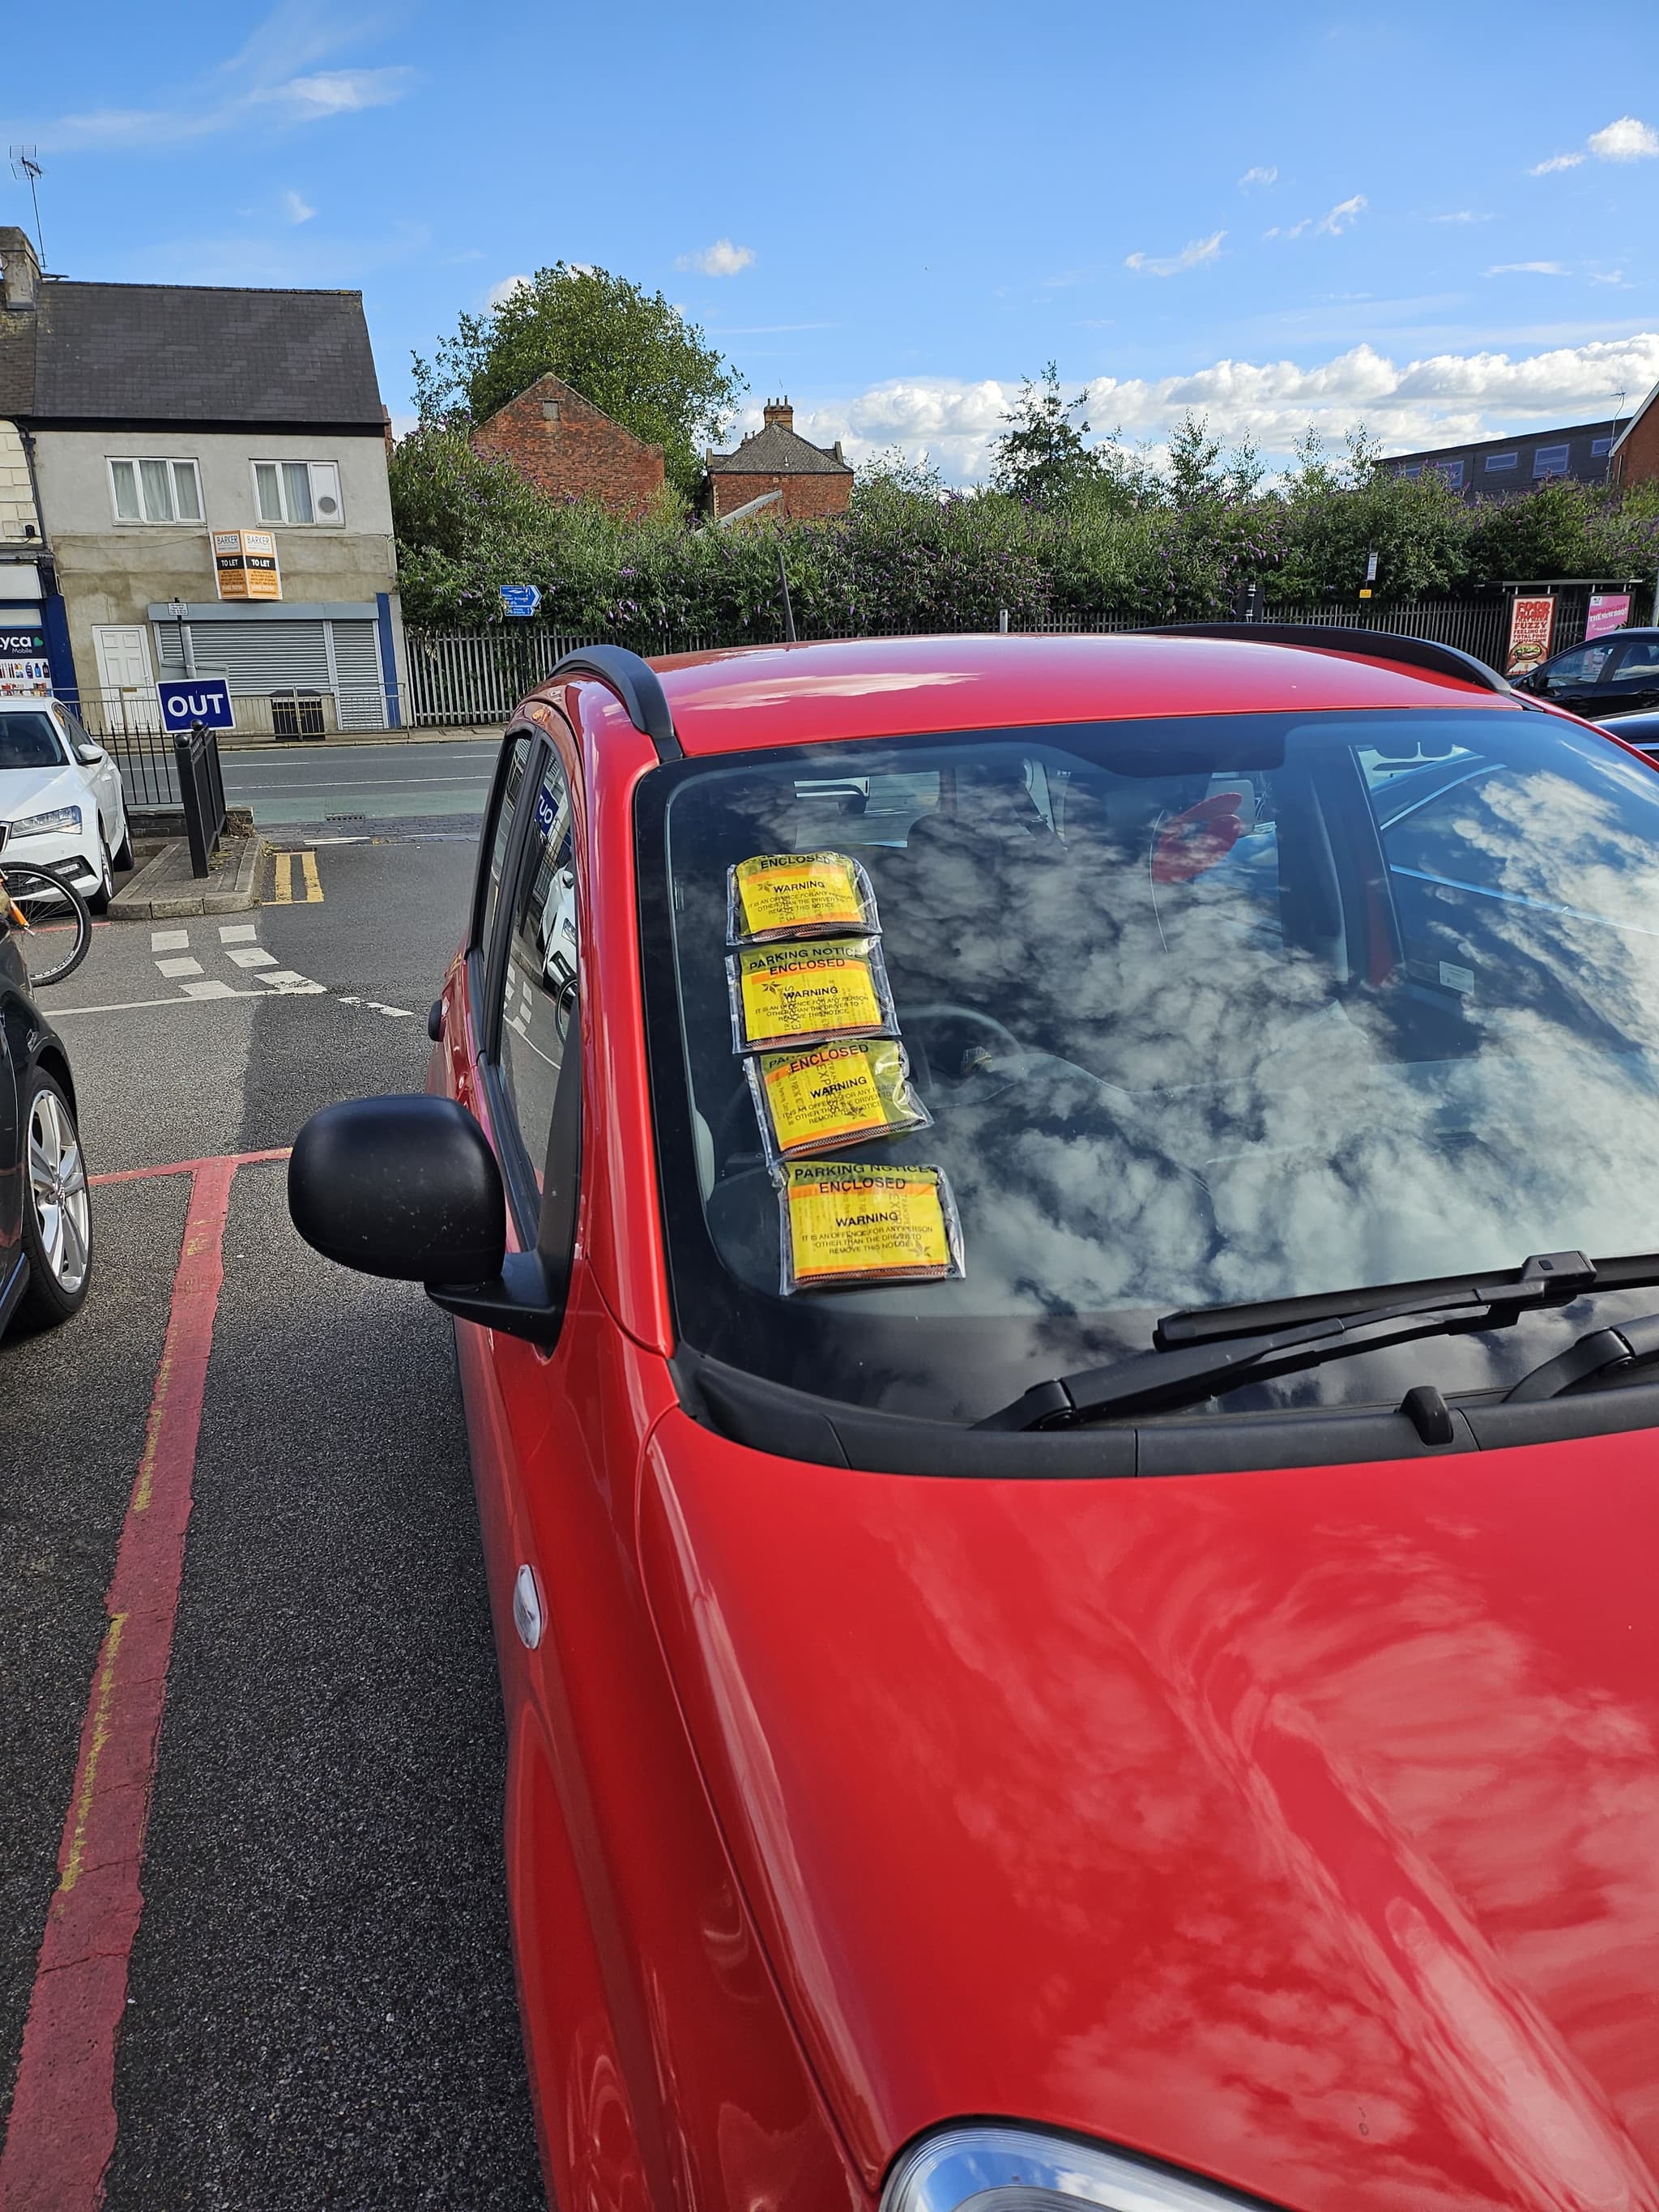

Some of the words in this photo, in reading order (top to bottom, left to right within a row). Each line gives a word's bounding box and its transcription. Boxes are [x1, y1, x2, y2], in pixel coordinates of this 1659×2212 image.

[216, 535, 238, 545] BARKER
[246, 535, 270, 545] BARKER
[220, 559, 228, 567] TO
[228, 559, 238, 567] LET
[250, 559, 259, 567] TO
[260, 559, 271, 568] LET
[1514, 621, 1547, 629] FUZZY
[167, 693, 224, 717] OUT
[760, 855, 830, 870] ENCLOSED
[773, 880, 825, 893] WARNING
[749, 949, 808, 970] PARKING
[812, 947, 862, 959] NOTICE
[770, 958, 846, 976] ENCLOSED
[783, 986, 838, 1000] WARNING
[789, 1043, 869, 1073] ENCLOSED
[810, 1076, 868, 1099] WARNING
[857, 1088, 871, 1096] ANY
[795, 1110, 820, 1120] OTHER
[795, 1165, 864, 1180] PARKING
[819, 1177, 906, 1194] ENCLOSED
[835, 1212, 898, 1227] WARNING
[815, 1240, 842, 1248] OTHER
[829, 1247, 861, 1255] REMOVE
